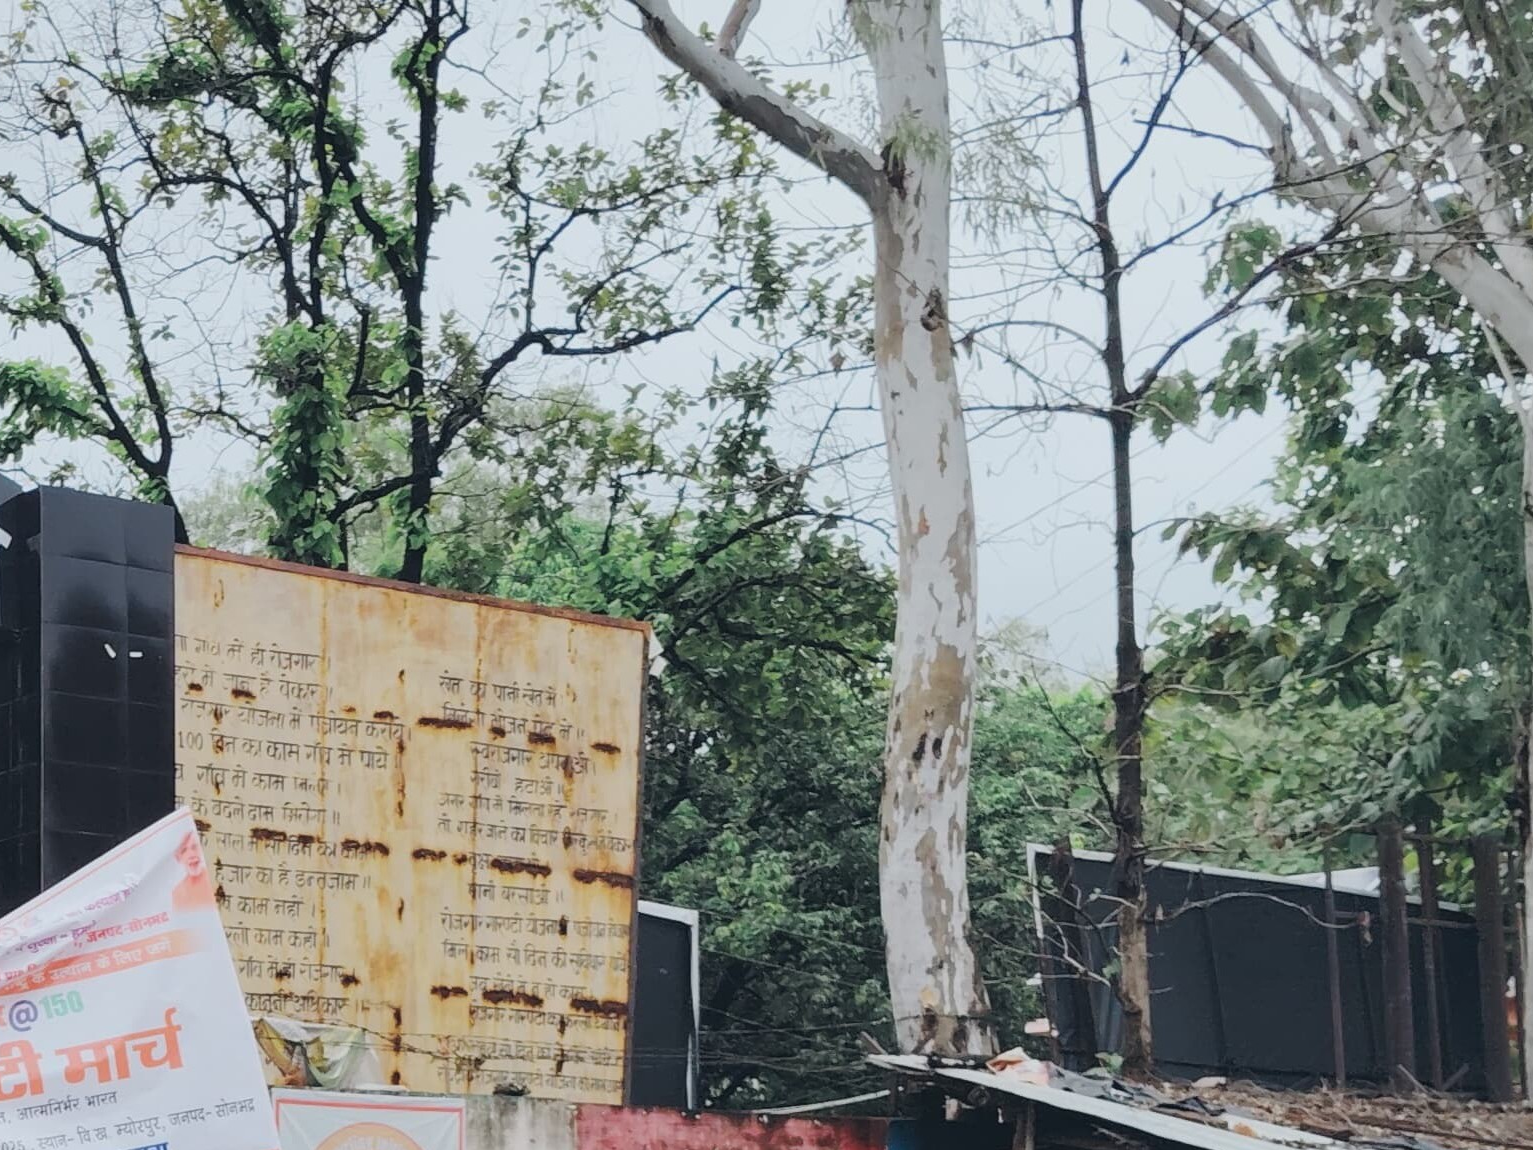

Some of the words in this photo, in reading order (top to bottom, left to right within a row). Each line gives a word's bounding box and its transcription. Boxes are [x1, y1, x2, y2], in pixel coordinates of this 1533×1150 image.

[177, 731, 204, 752] 100
[267, 740, 301, 763] काम
[252, 772, 287, 794] काम
[237, 895, 271, 916] काम
[253, 927, 286, 948] काम
[55, 1007, 185, 1086] मार्च
[16, 1094, 81, 1122] आत्मनिर्भर
[84, 1090, 118, 1110] भारत
[214, 1097, 256, 1119] सोनभद्र
